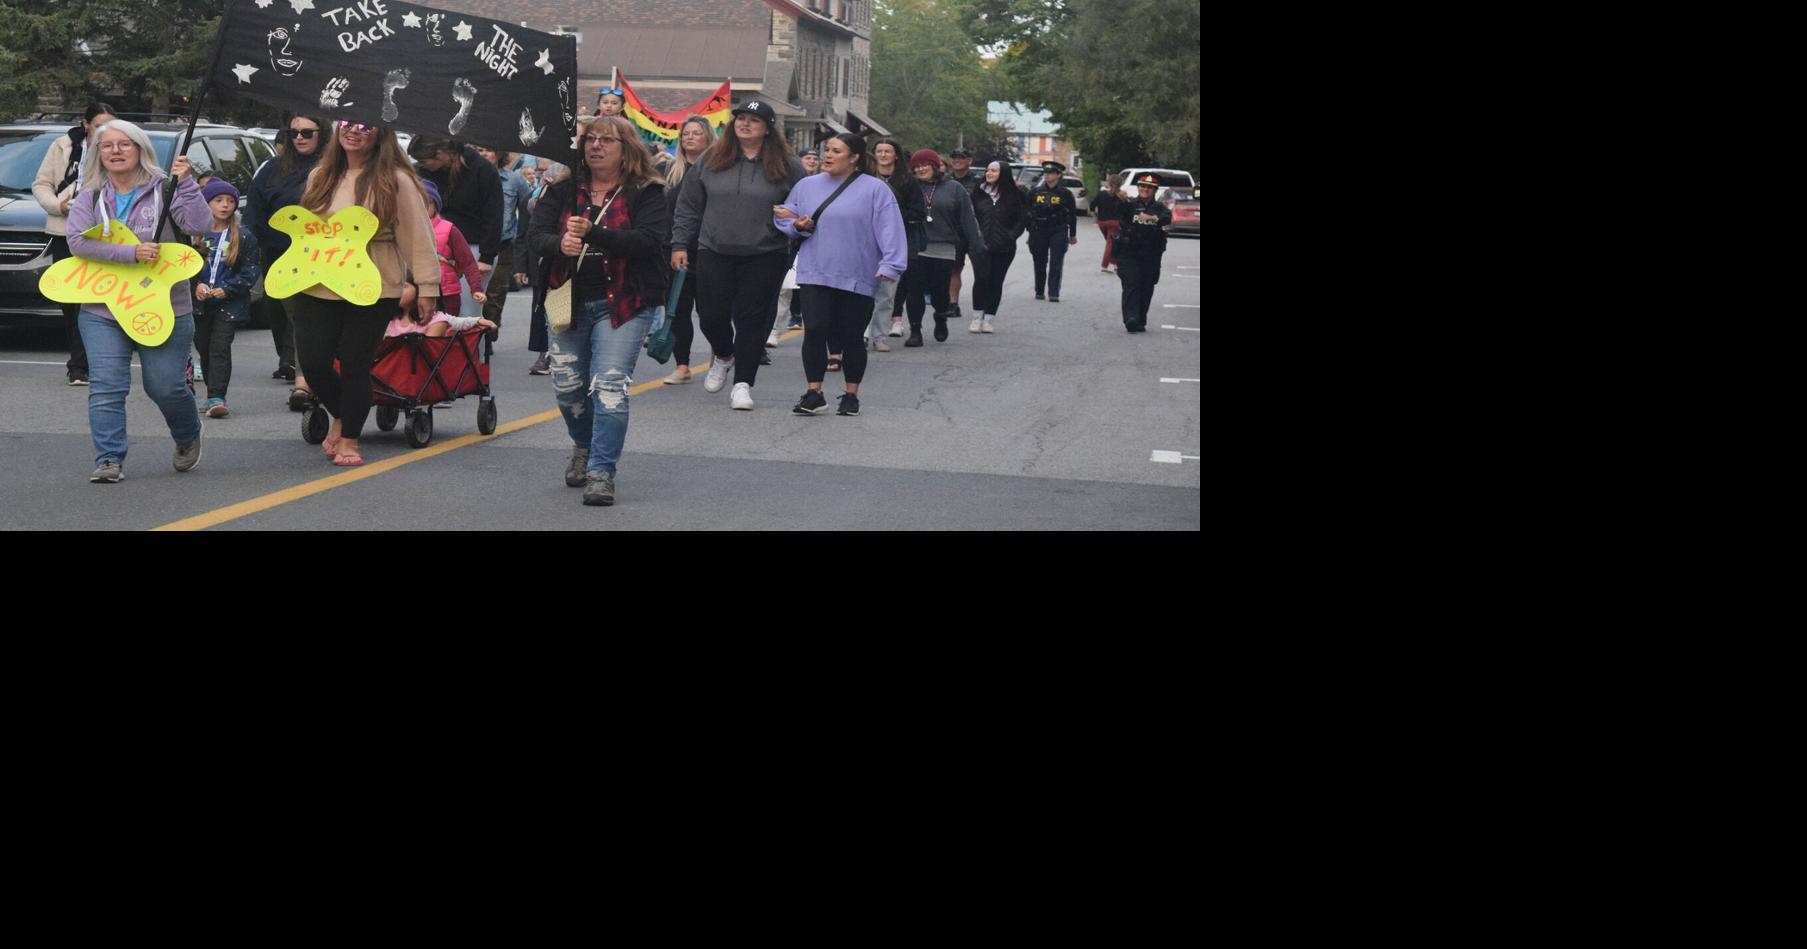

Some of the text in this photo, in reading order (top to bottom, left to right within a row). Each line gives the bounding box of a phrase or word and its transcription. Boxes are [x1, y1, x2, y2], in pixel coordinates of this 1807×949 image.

[321, 0, 389, 27] TAKE
[337, 18, 396, 53] BACK
[491, 23, 524, 64] THE
[304, 221, 343, 237] STOP
[310, 246, 356, 268] IT!
[64, 262, 156, 311] NOW
